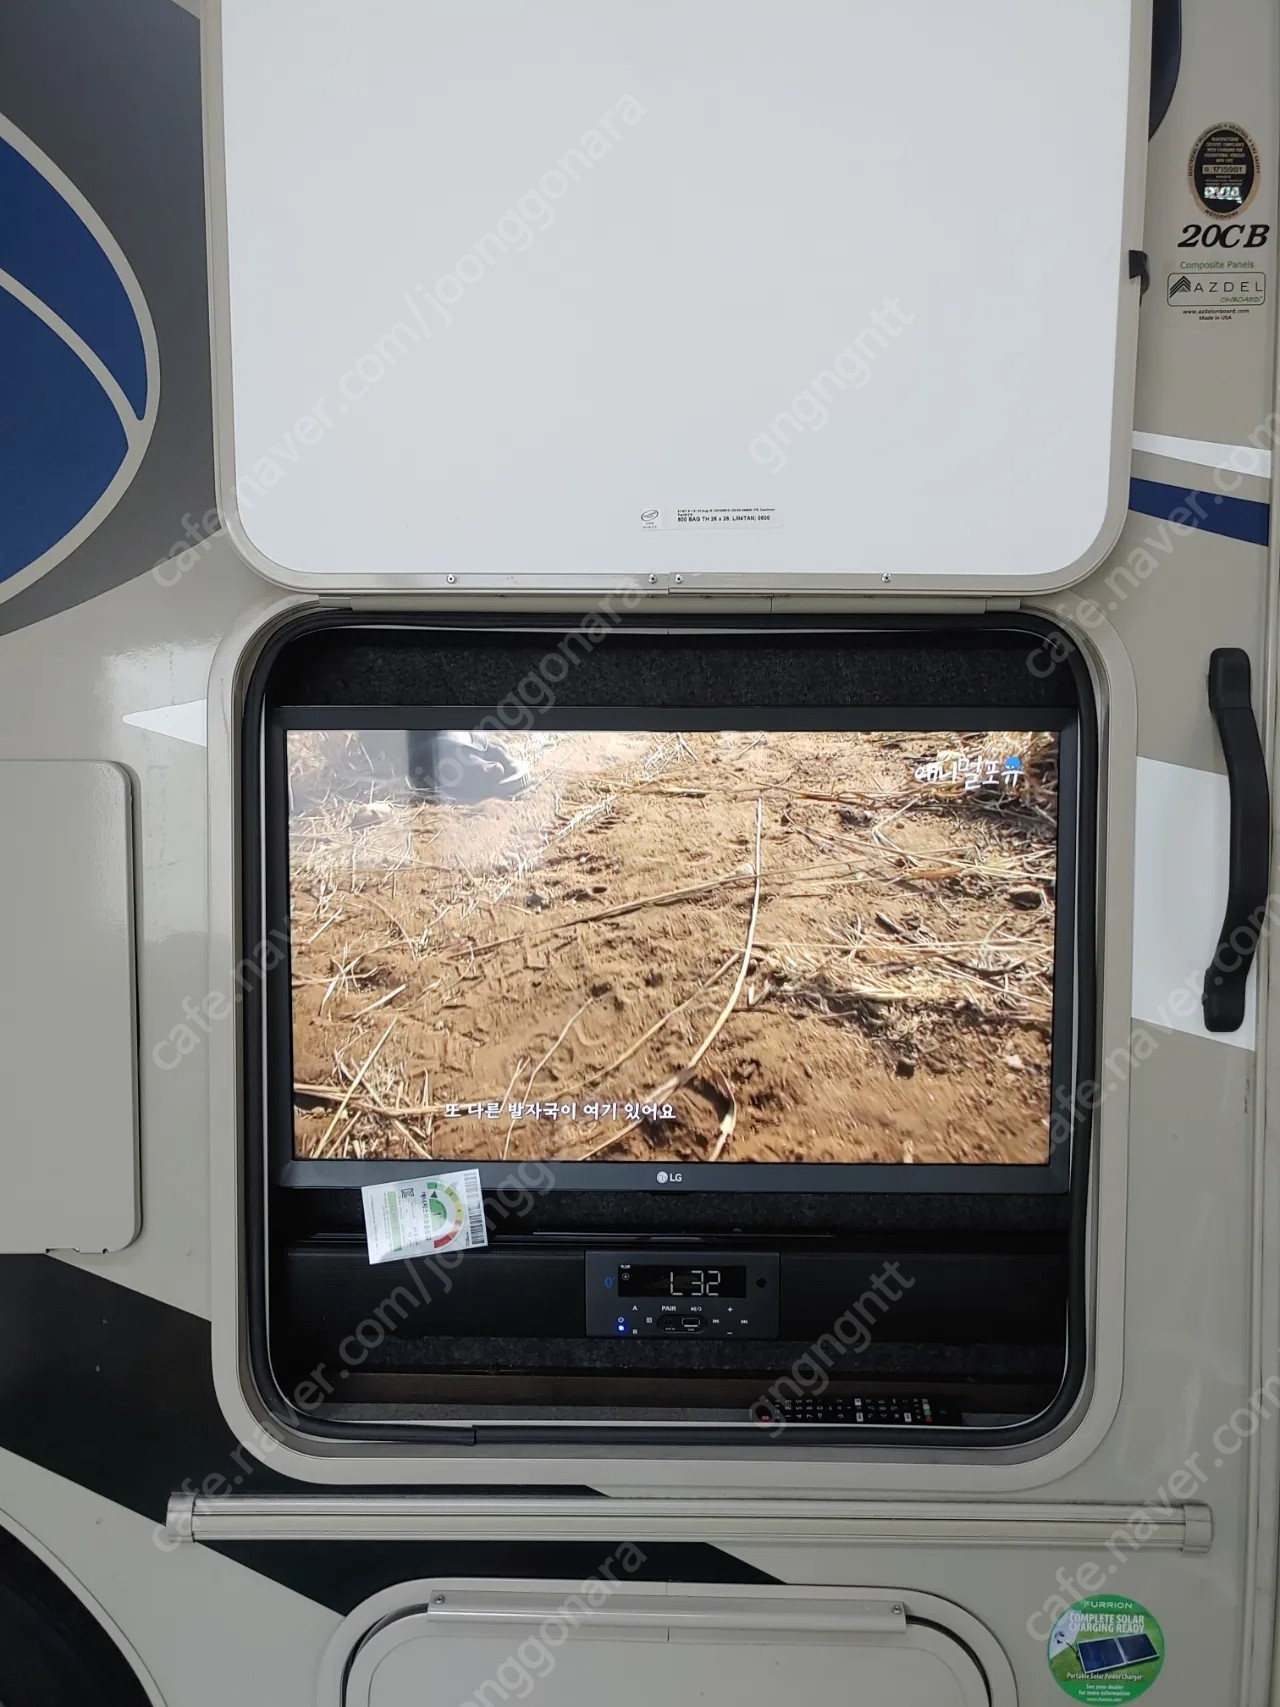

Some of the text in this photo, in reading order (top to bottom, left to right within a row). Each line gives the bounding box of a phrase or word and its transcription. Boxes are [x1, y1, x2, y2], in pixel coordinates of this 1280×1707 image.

[1180, 260, 1255, 270] Composite Panels
[1193, 281, 1263, 292] AZDEL
[444, 1101, 677, 1120] 또 다른 발자국이 여기 있어요
[1083, 1601, 1133, 1609] FURRION
[1069, 1613, 1145, 1624] COMPLETE SOLAR
[1069, 1622, 1145, 1633] CHARGING READY
[1067, 1672, 1089, 1680] Portable
[1090, 1672, 1104, 1680] Solar
[1122, 1673, 1143, 1682] Charger
